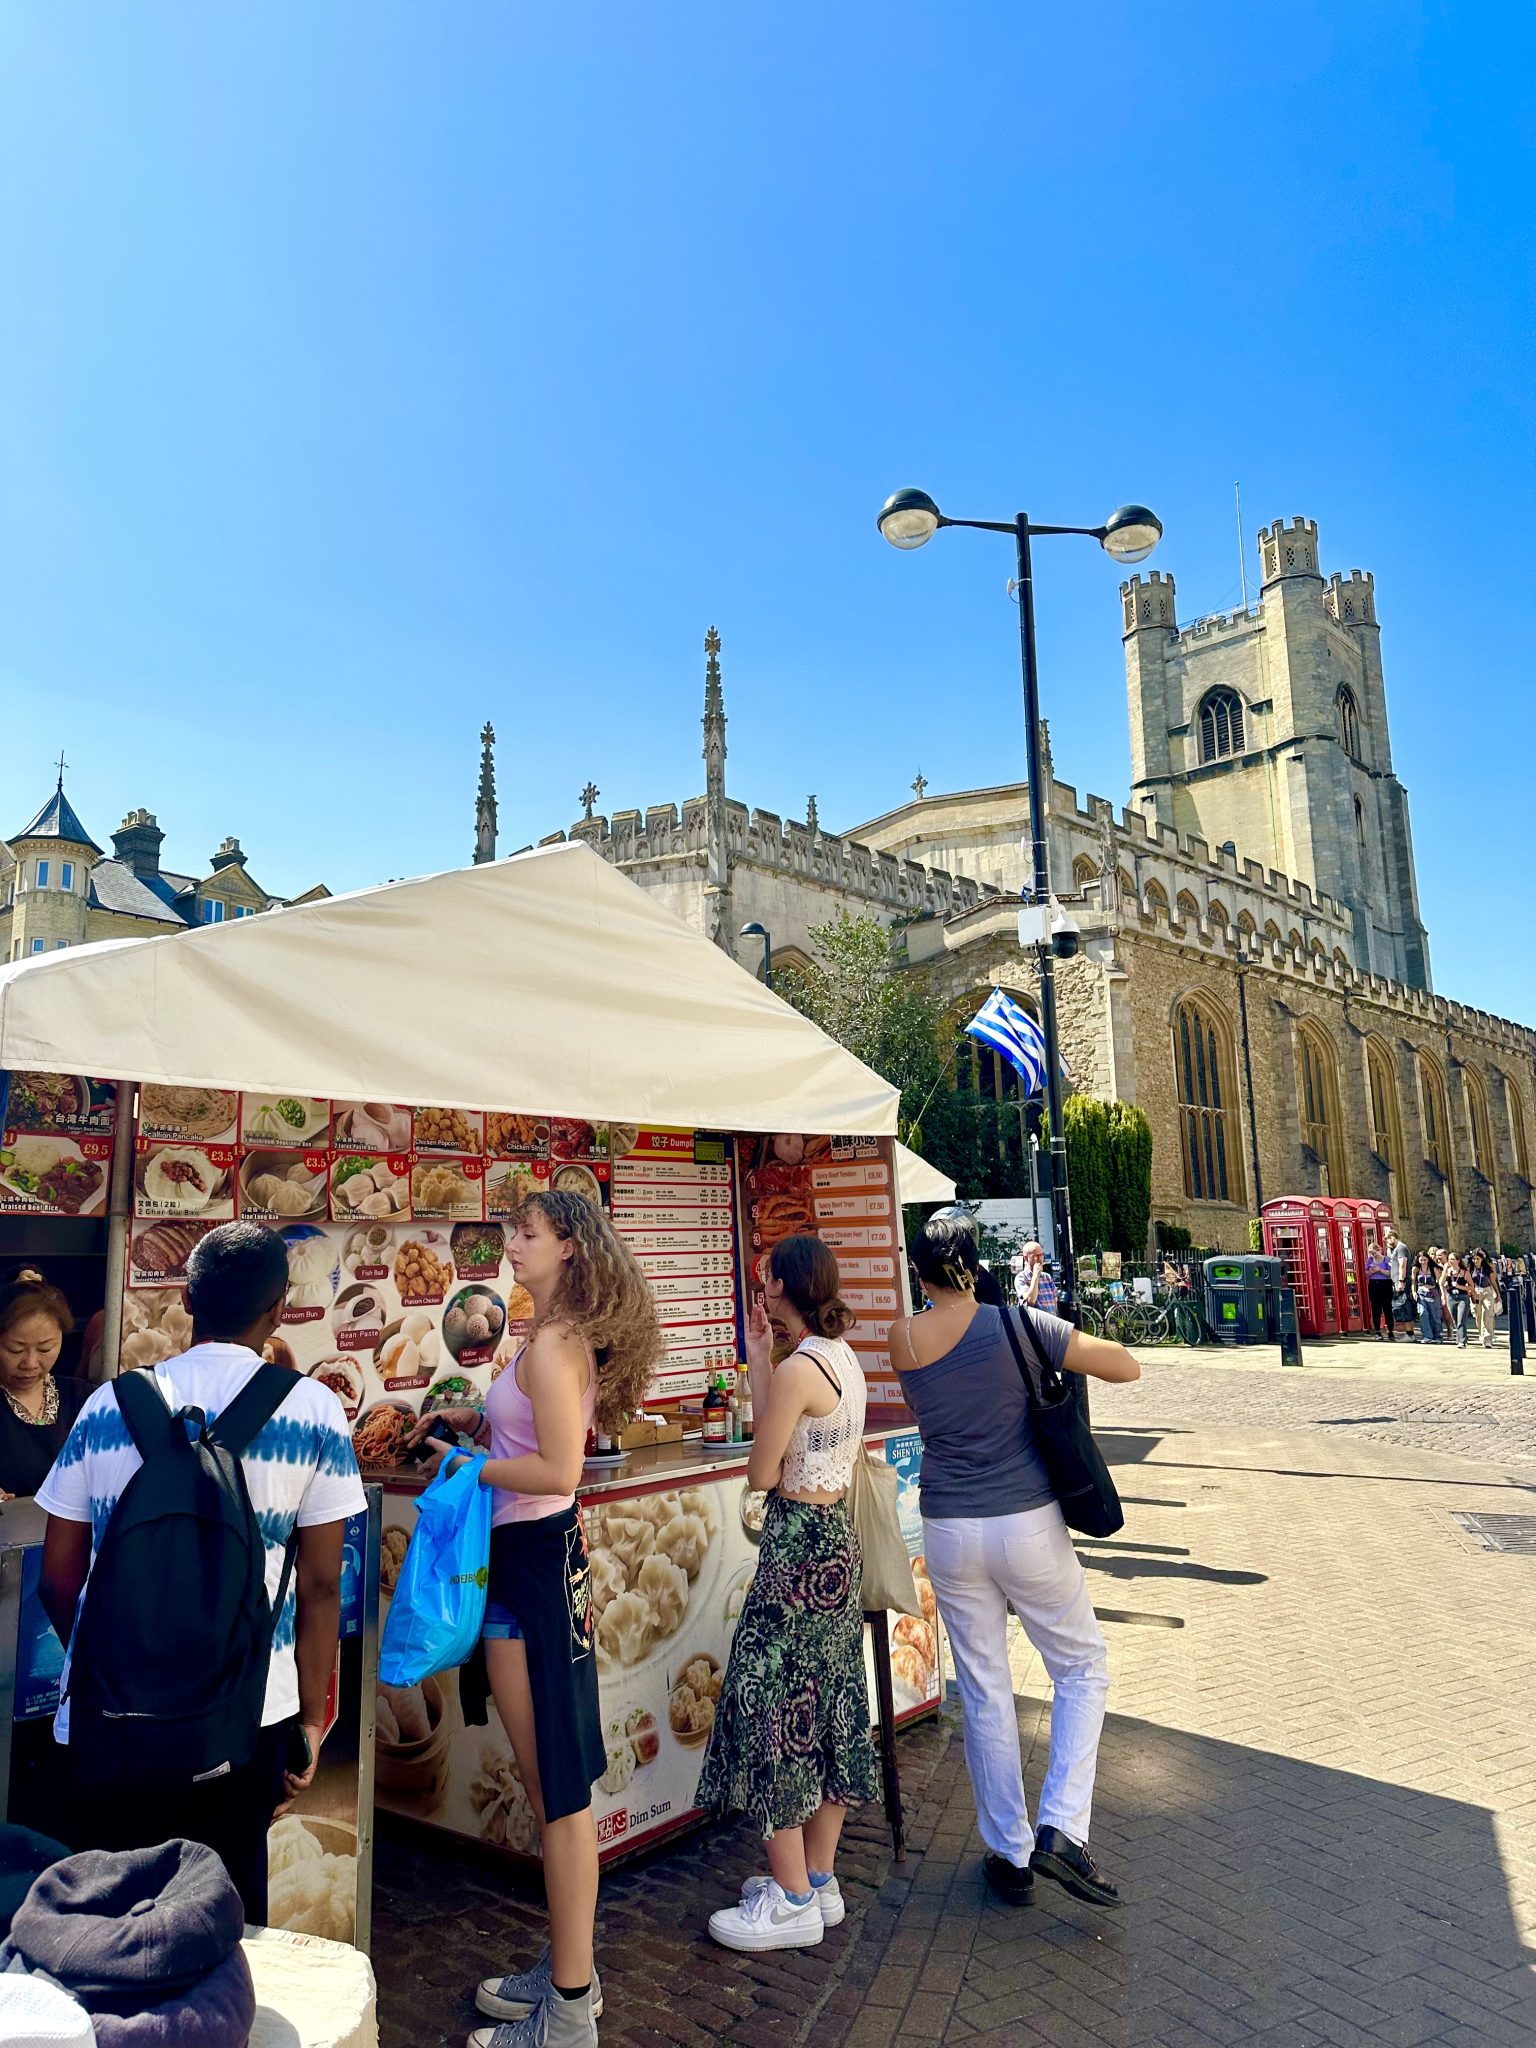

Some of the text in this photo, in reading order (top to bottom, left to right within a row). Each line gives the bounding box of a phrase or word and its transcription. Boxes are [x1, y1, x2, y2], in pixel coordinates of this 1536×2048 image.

[143, 1131, 204, 1141] Scallion Pancake
[137, 1140, 148, 1150] 11
[652, 1136, 694, 1148] 饺子 Dumpli
[83, 1144, 109, 1154] £9.5
[234, 1146, 246, 1155] 14
[211, 1151, 233, 1161] £3.5
[326, 1152, 336, 1160] 17
[408, 1154, 417, 1162] 20
[306, 1158, 326, 1168] £3.5
[393, 1162, 404, 1170] £4
[482, 1158, 492, 1167] 23
[548, 1161, 557, 1169] 26
[465, 1165, 482, 1173] £3.5
[537, 1166, 545, 1174] £5
[750, 1176, 756, 1188] 1
[752, 1207, 758, 1217] 2
[754, 1234, 760, 1245] 3
[758, 1293, 764, 1304] 5
[879, 1328, 890, 1336] £6.
[388, 1380, 411, 1388] Custard
[892, 1448, 910, 1459] SHEN
[630, 1801, 671, 1828] Dim Sum
